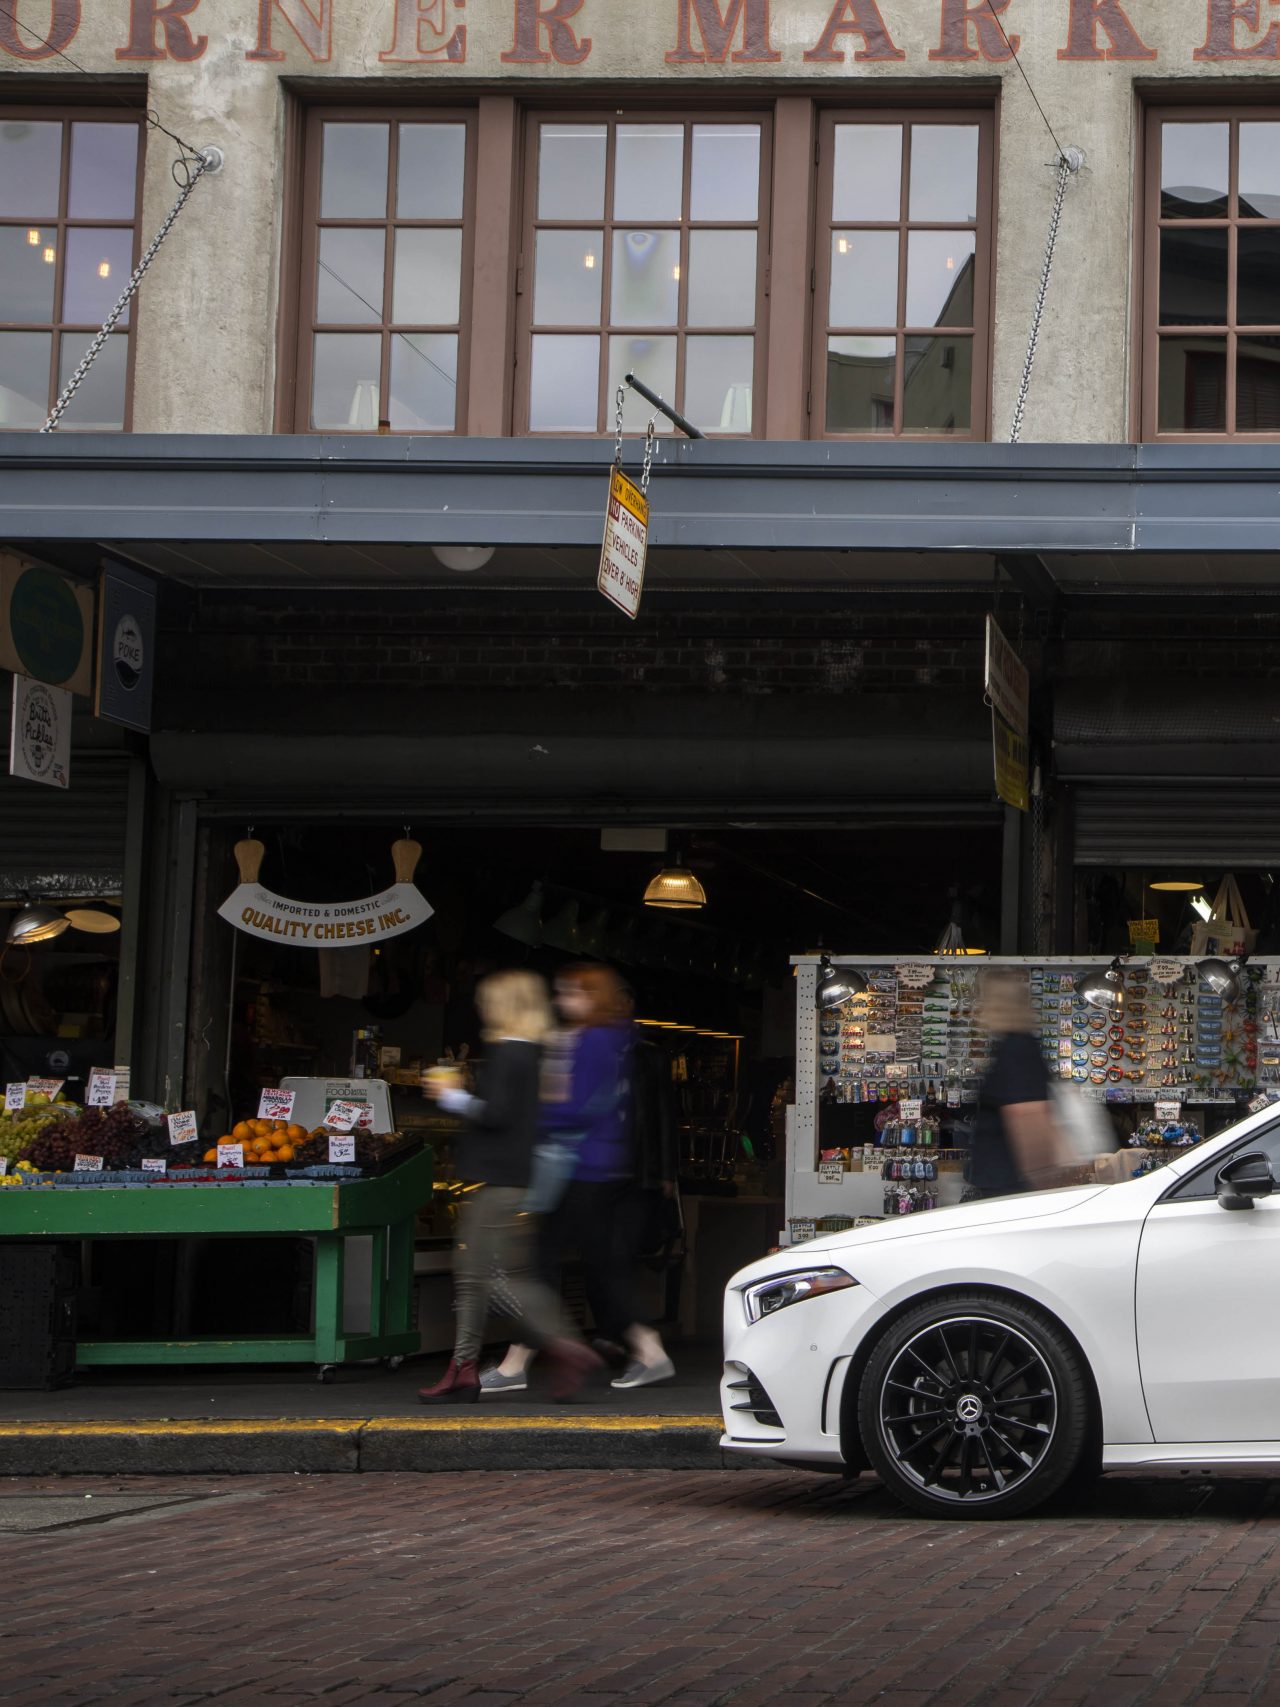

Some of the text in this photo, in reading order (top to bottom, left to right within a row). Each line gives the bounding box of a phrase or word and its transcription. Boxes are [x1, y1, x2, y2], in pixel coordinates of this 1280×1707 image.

[613, 479, 623, 496] LOW
[610, 500, 645, 544] NO PARKING
[611, 532, 639, 568] VEHICLES
[603, 558, 619, 582] OVER
[626, 576, 639, 600] HIGH
[118, 641, 140, 662] POKE
[26, 721, 54, 746] Pickles
[272, 900, 381, 917] IMPORTED & DOMESTIC
[241, 906, 411, 939] QUALITY CHEESE INC.
[326, 1088, 351, 1096] FOOD
